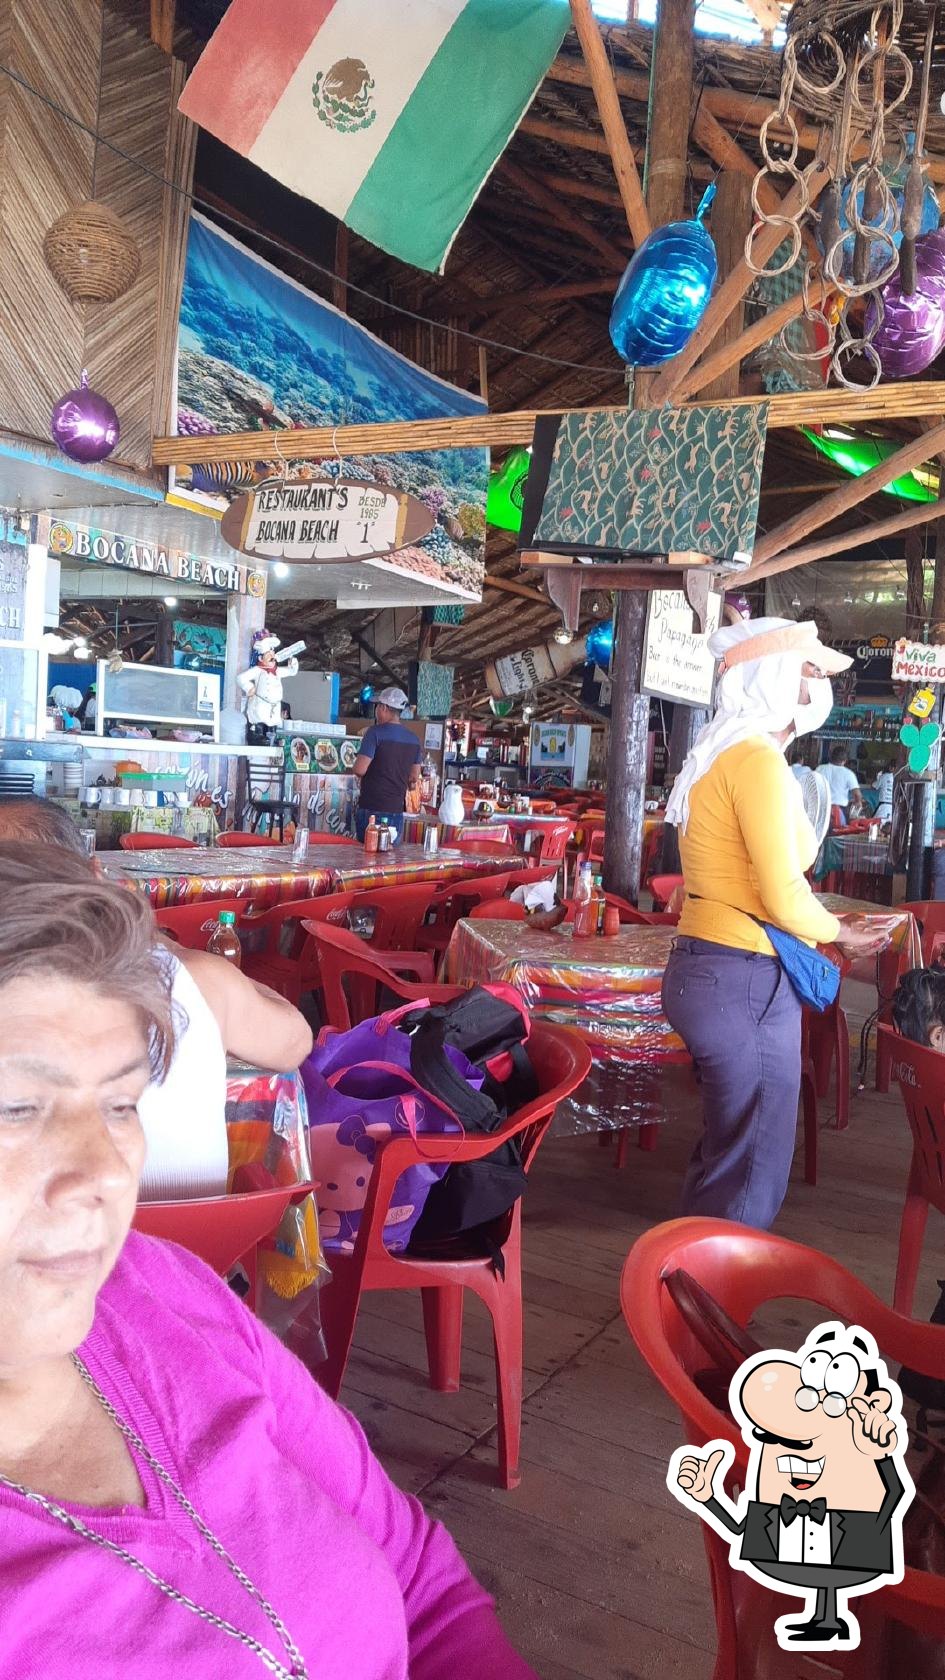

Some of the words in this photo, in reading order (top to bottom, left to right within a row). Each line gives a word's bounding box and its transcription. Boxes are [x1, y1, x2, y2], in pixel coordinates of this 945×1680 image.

[257, 487, 349, 512] RESTAURANT'S
[360, 508, 379, 519] 1985
[256, 520, 295, 543] BOCANA
[299, 520, 339, 543] BEACH
[75, 531, 170, 575] BOCANA
[177, 556, 240, 591] BEACH
[856, 645, 893, 670] Coron
